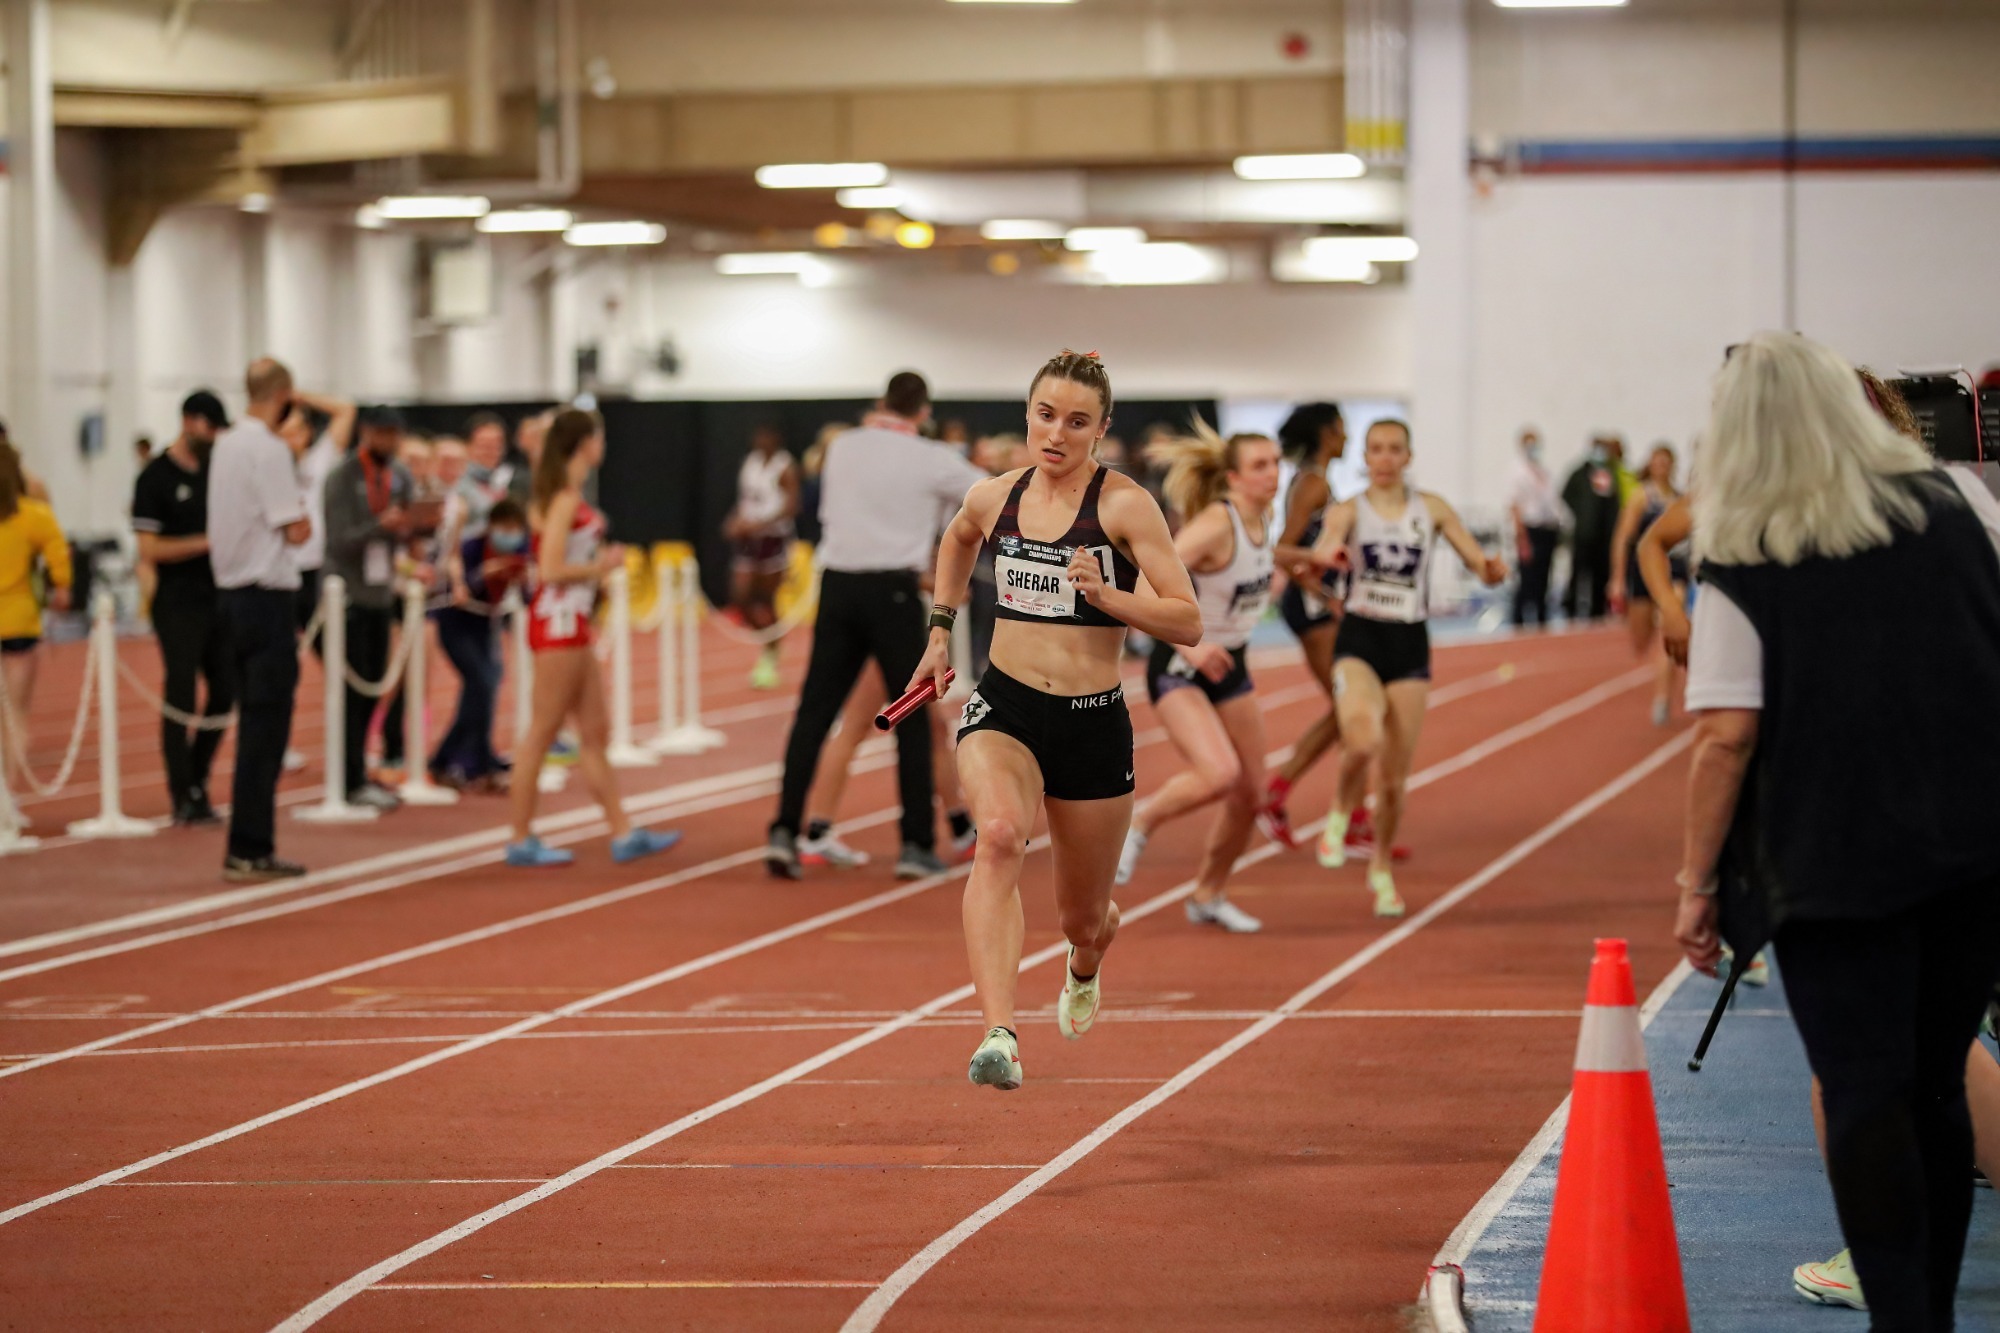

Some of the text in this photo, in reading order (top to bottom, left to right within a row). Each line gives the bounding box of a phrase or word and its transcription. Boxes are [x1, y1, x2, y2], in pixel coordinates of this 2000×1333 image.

[1041, 545, 1054, 554] TRACK
[1028, 551, 1062, 562] CHAMPIONSHIPS
[1007, 568, 1060, 594] SHERAR
[1071, 695, 1108, 710] NIKE
